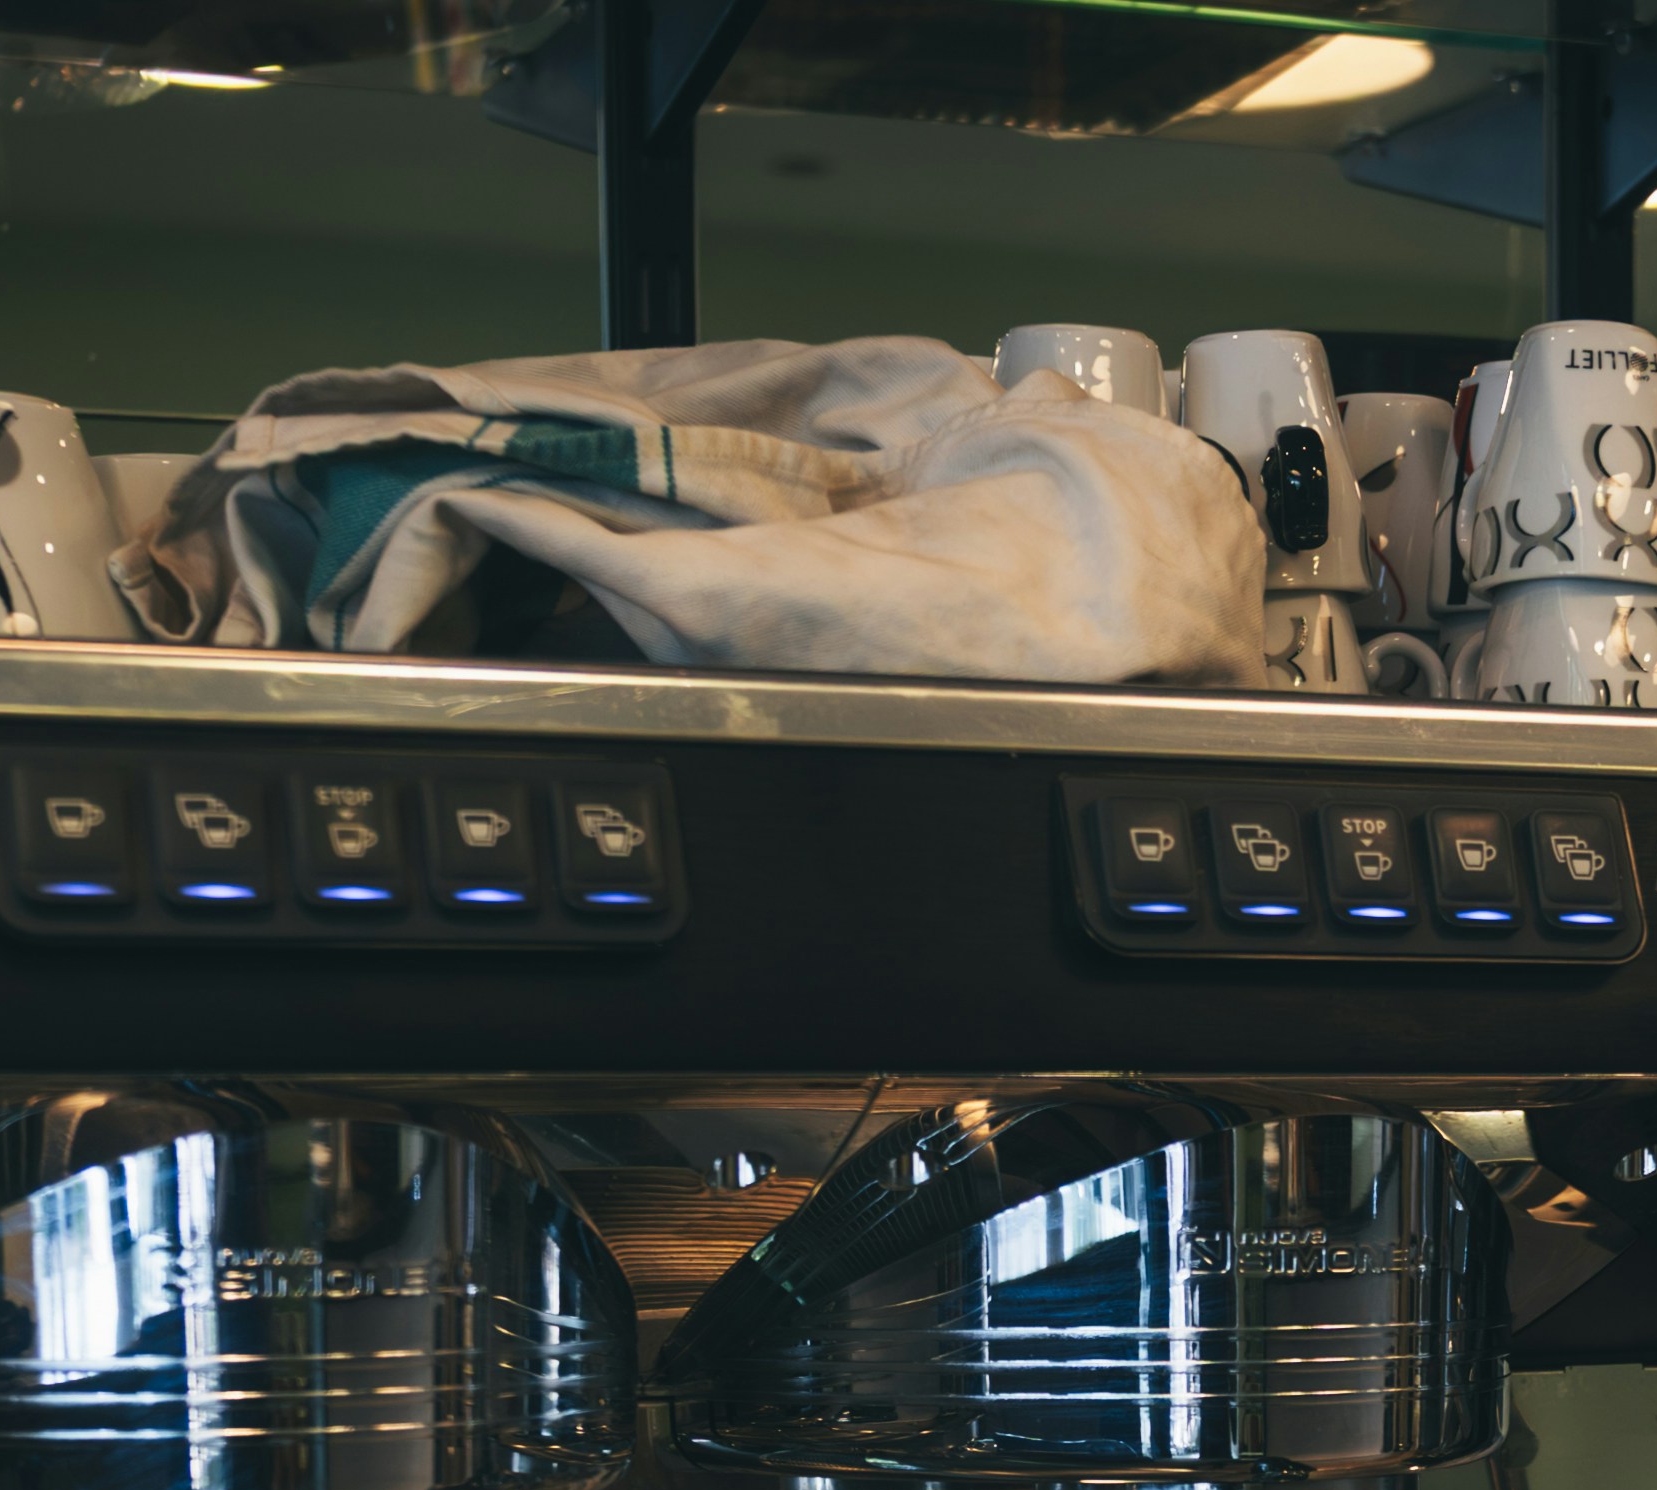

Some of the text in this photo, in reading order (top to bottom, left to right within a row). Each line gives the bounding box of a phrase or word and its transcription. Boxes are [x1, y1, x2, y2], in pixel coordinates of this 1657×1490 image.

[314, 785, 373, 805] STOP
[1342, 818, 1387, 835] STOP
[1239, 1227, 1327, 1245] nuova
